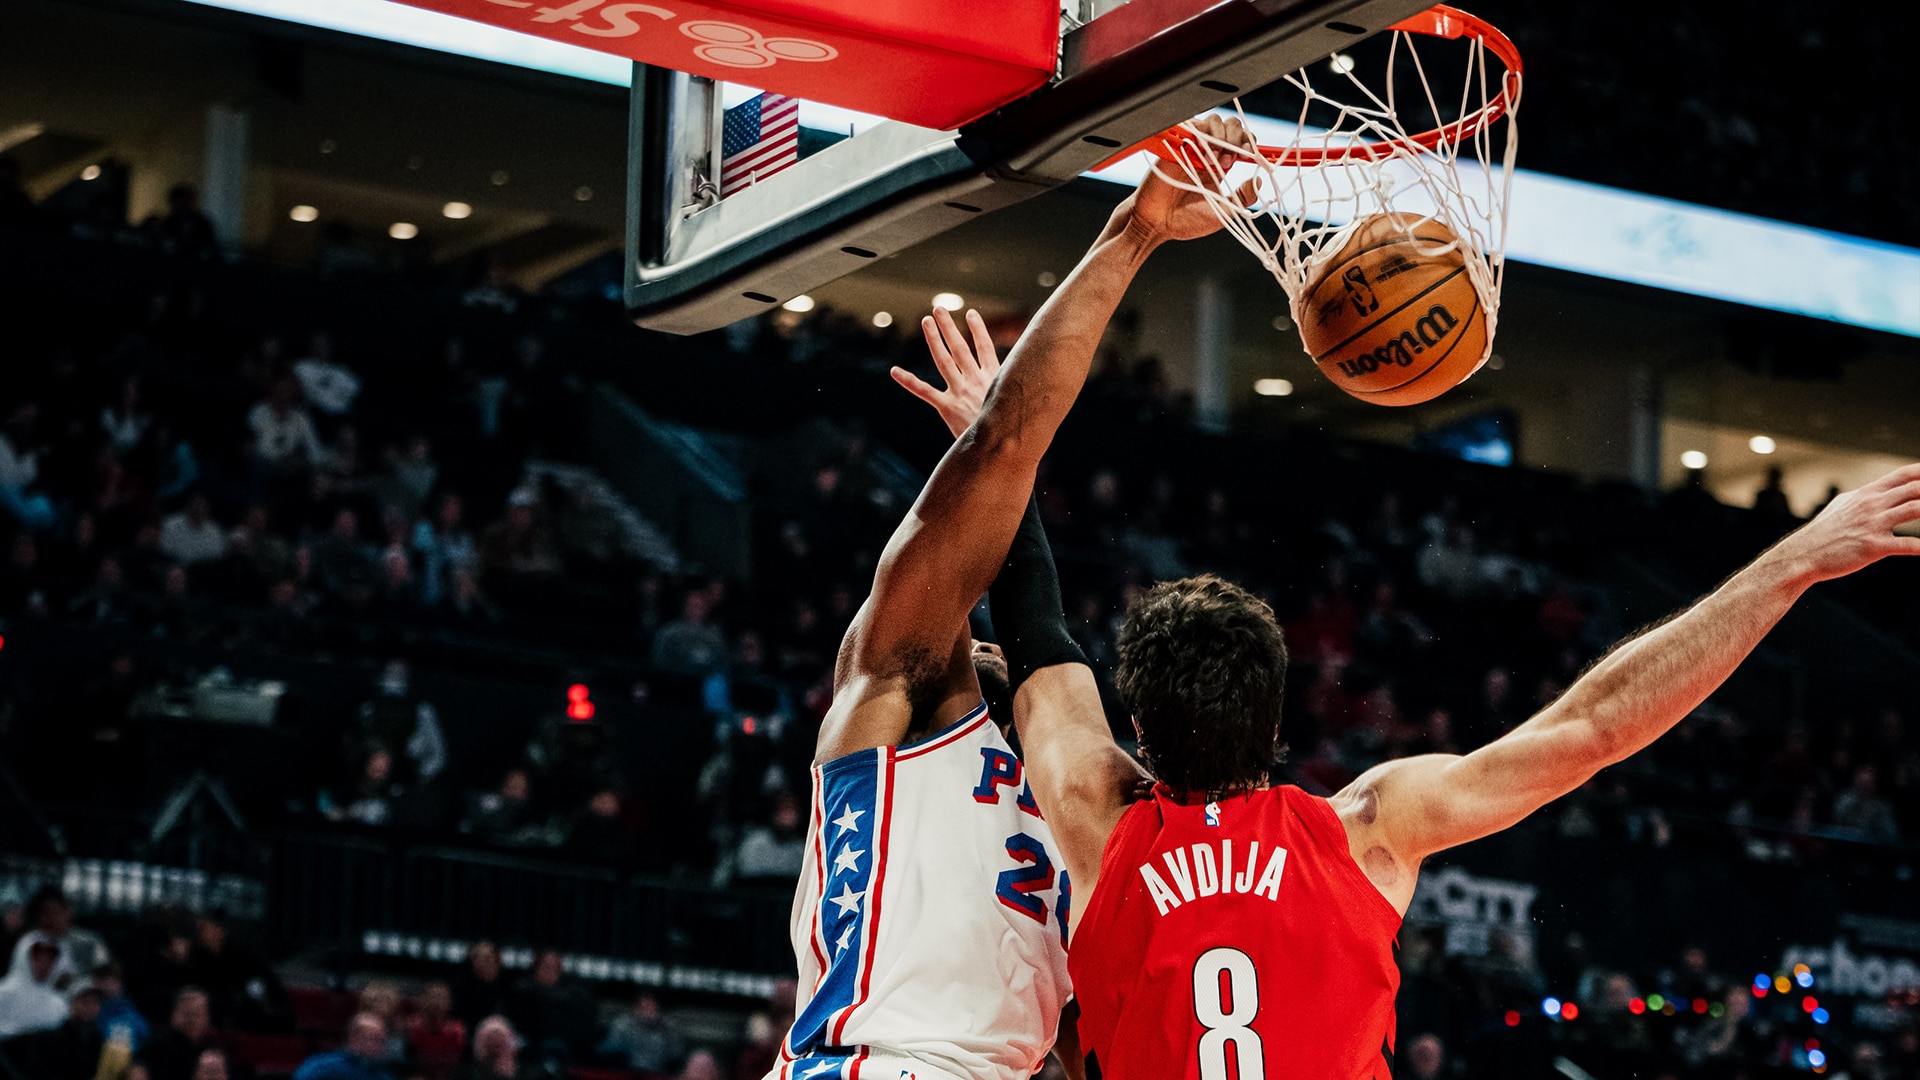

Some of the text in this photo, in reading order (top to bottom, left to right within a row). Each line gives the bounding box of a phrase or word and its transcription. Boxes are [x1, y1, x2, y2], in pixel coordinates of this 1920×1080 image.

[1336, 304, 1458, 378] Wilson
[1139, 839, 1288, 917] AVDIJA
[1192, 946, 1267, 1080] 8
